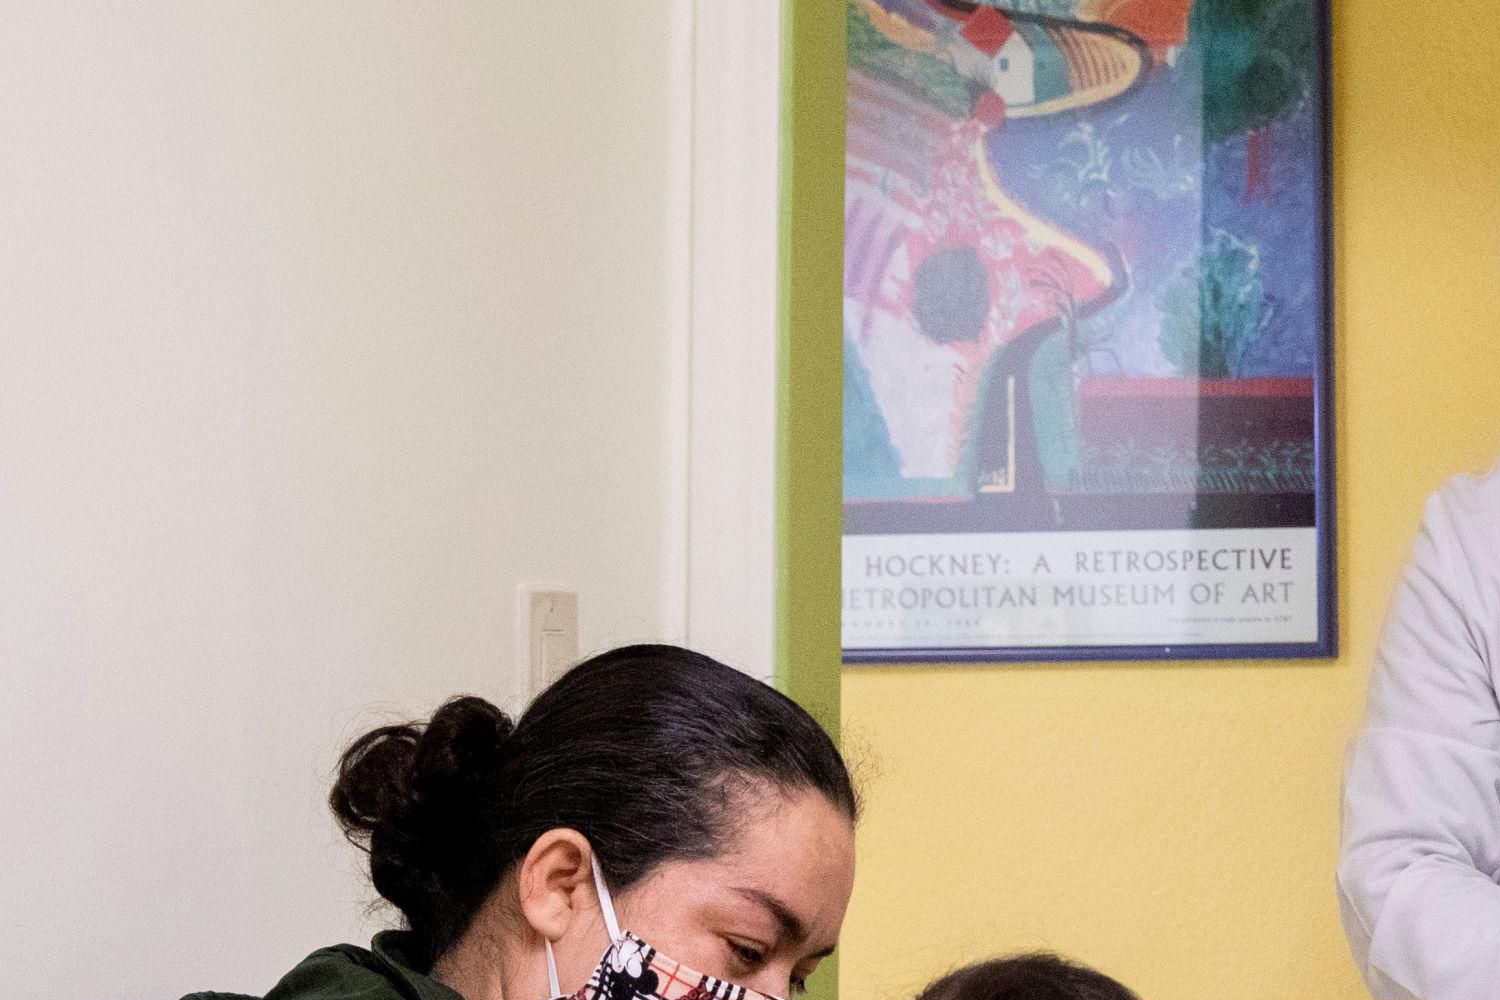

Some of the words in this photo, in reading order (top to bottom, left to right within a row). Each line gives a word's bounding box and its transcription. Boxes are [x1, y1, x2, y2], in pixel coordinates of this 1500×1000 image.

[864, 553, 1011, 578] HOCKNEY:
[1032, 553, 1052, 574] A
[1075, 548, 1293, 574] RETROSPECTIVE
[842, 586, 1037, 610] ETROPOLITAN
[1053, 583, 1175, 607] MUSEUM
[1189, 582, 1225, 605] OF
[1241, 581, 1294, 604] ART
